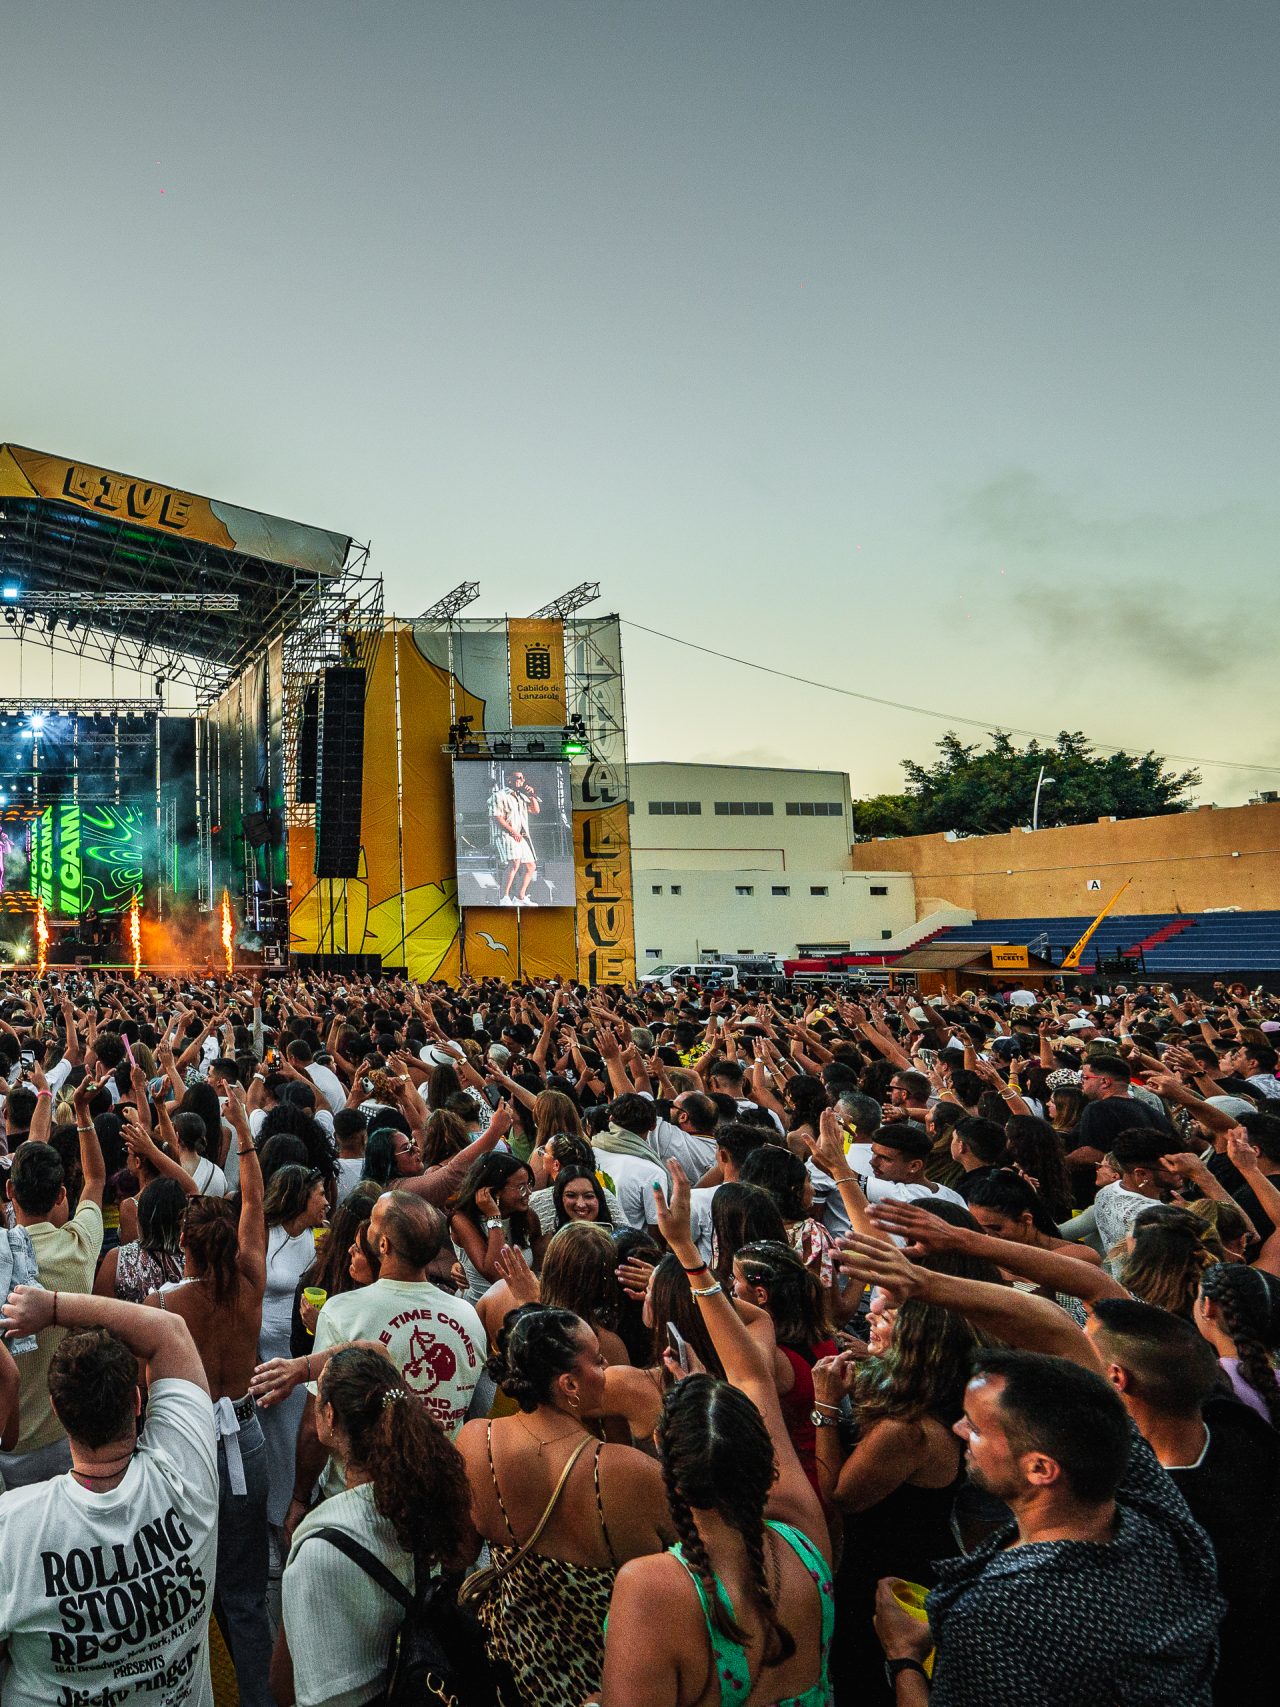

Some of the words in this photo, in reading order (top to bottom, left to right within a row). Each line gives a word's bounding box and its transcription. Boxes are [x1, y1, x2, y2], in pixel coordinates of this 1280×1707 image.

[61, 465, 193, 529] LIVE
[516, 684, 549, 692] Cabildo
[550, 684, 561, 692] de
[518, 692, 560, 700] Lanzarote
[30, 817, 38, 875] CAMA
[41, 805, 53, 880] CAMA
[583, 816, 626, 987] LIVE
[1091, 880, 1100, 890] A
[388, 1309, 433, 1329] TIME
[437, 1312, 477, 1368] COMES
[40, 1506, 194, 1598] ROLLING
[58, 1554, 195, 1635] STONES
[112, 1654, 166, 1679] PRESENTS
